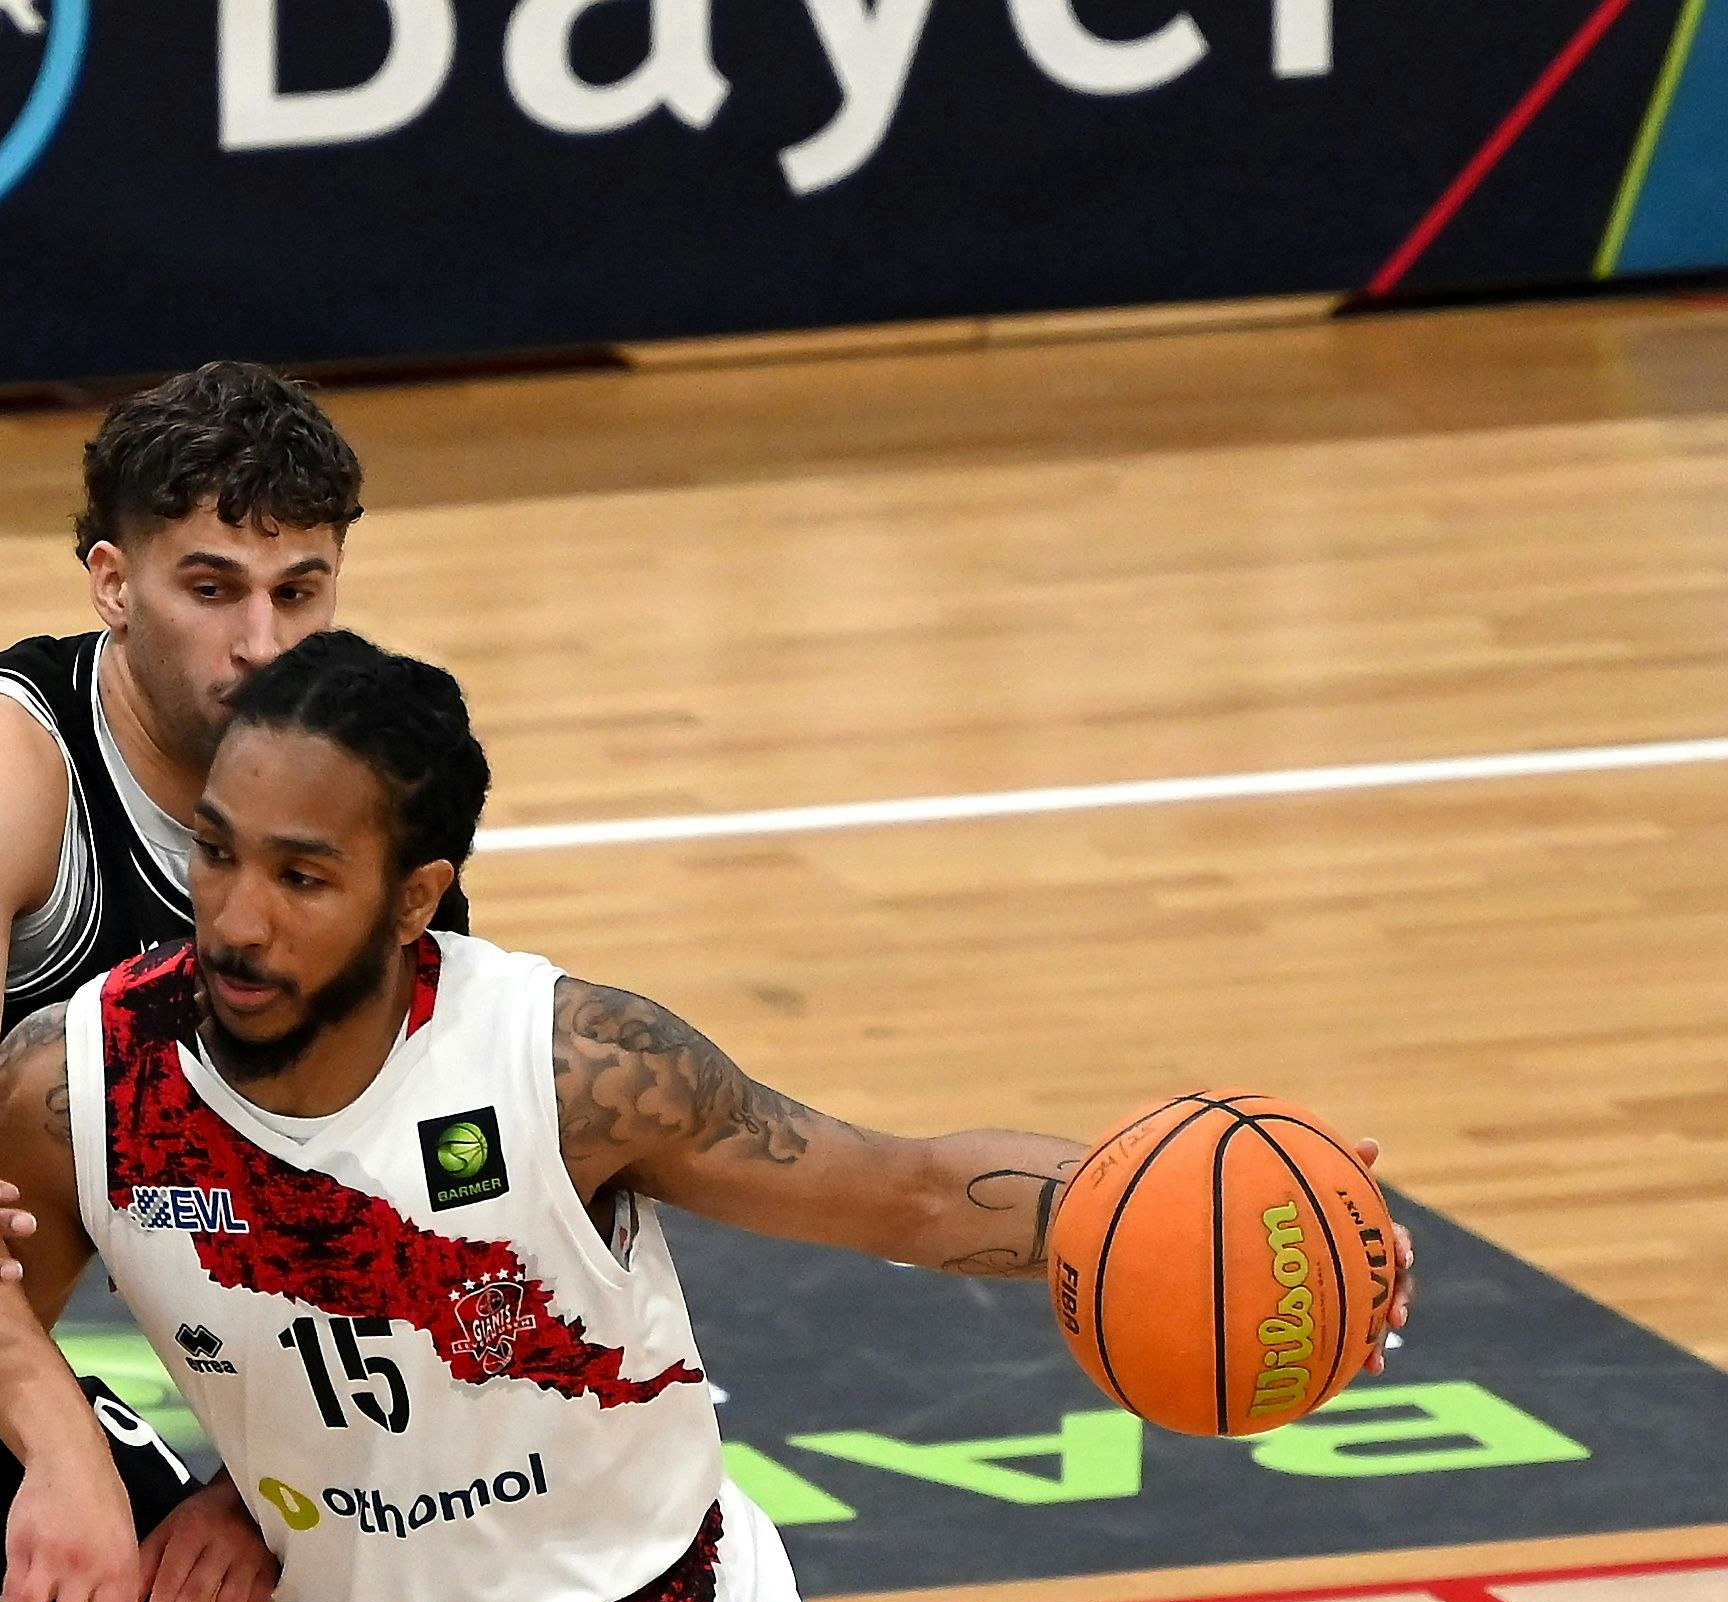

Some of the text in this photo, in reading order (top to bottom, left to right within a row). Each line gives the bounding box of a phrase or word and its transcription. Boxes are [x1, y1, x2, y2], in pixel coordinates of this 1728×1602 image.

[169, 1188, 250, 1232] EVL
[437, 1177, 502, 1202] BARMER
[1335, 1190, 1363, 1225] NXT
[1061, 1261, 1081, 1335] FIBA
[1247, 1201, 1315, 1418] Wilson
[472, 1303, 512, 1342] GIANTS
[184, 1356, 238, 1375] errea
[277, 1316, 410, 1434] 15
